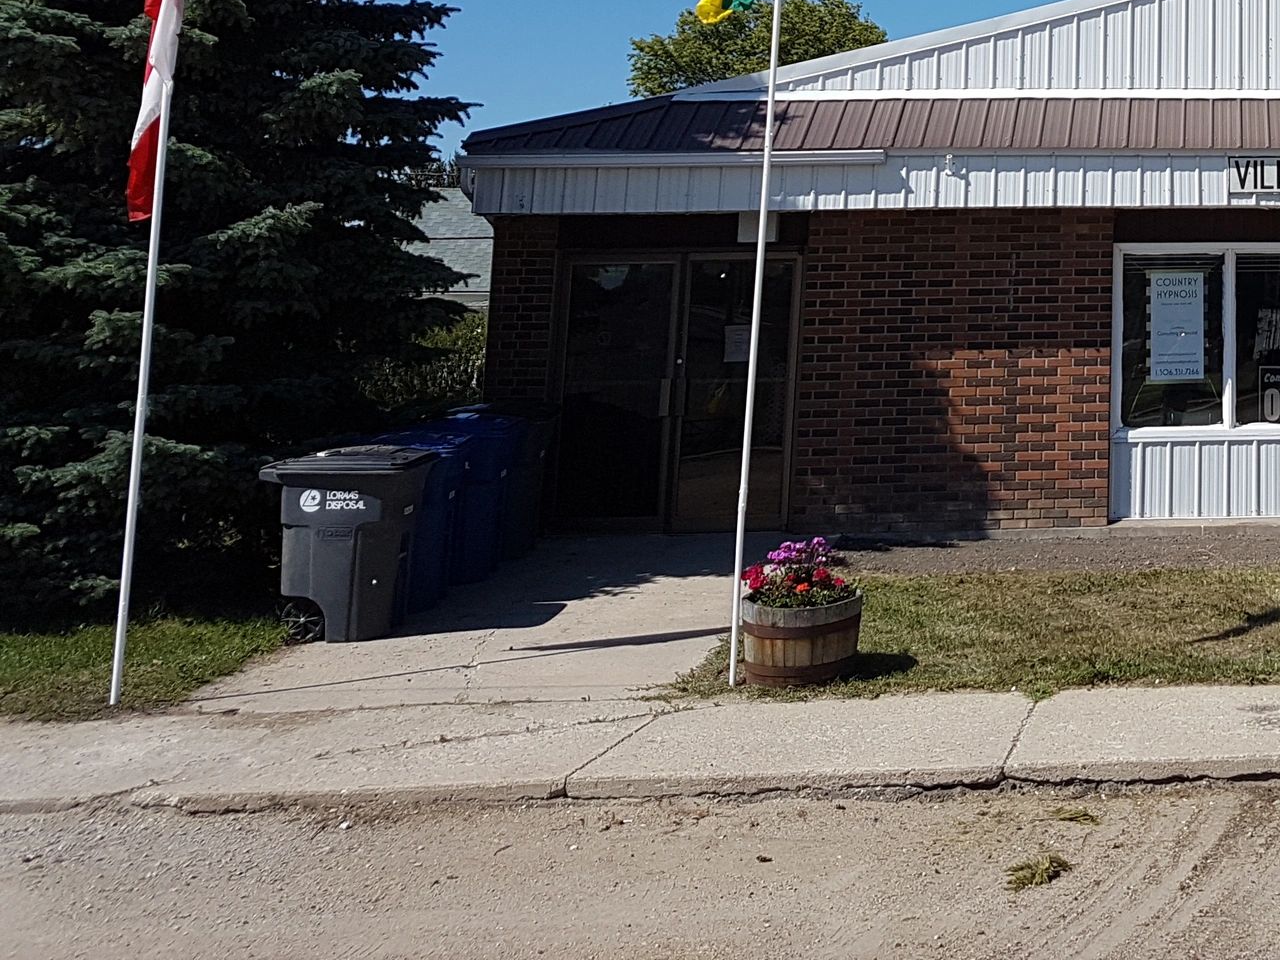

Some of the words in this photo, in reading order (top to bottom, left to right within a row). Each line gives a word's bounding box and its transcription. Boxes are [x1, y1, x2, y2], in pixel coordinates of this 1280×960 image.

[1156, 277, 1198, 286] COUNTRY
[1156, 289, 1198, 299] HYPNOSIS
[326, 490, 359, 500] LORAAS
[326, 500, 366, 510] DISPOSAL
